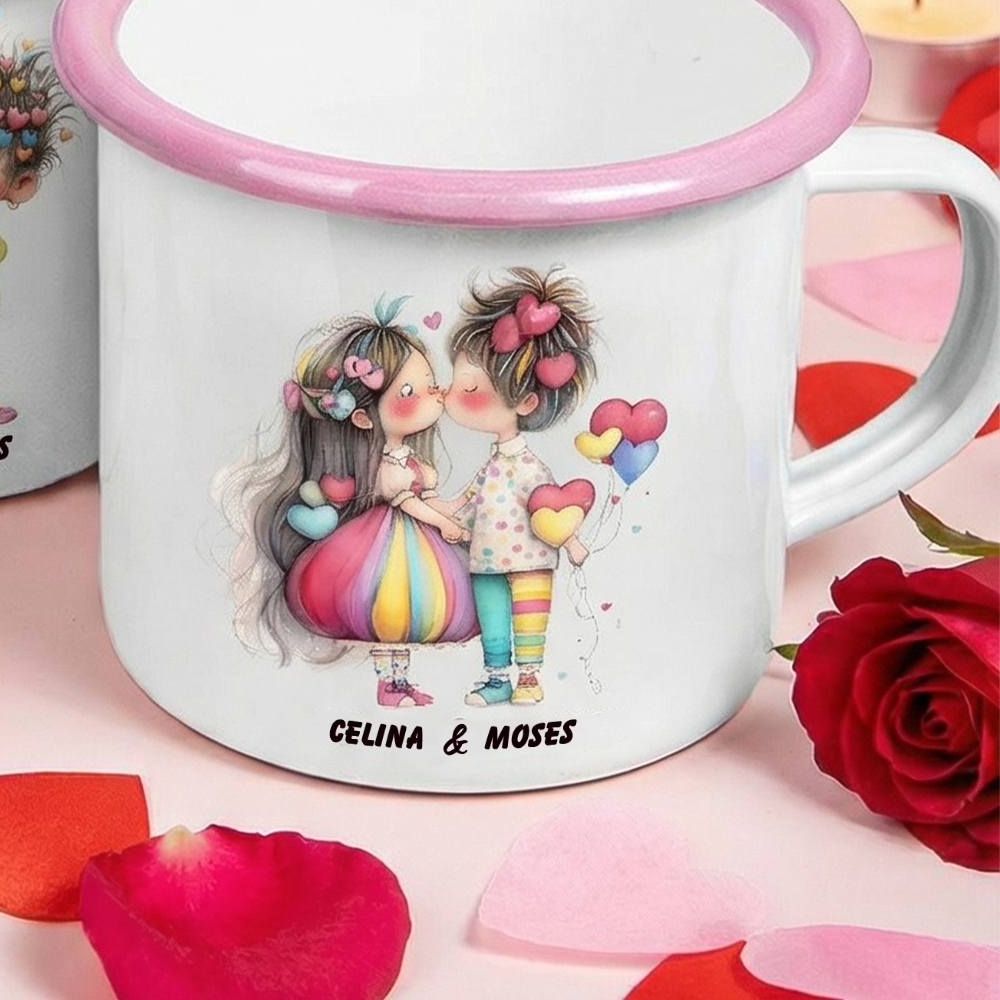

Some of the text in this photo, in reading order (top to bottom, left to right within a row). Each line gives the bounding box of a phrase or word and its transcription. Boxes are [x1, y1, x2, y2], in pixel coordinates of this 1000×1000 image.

[329, 718, 577, 756] CELINA & MOSES
